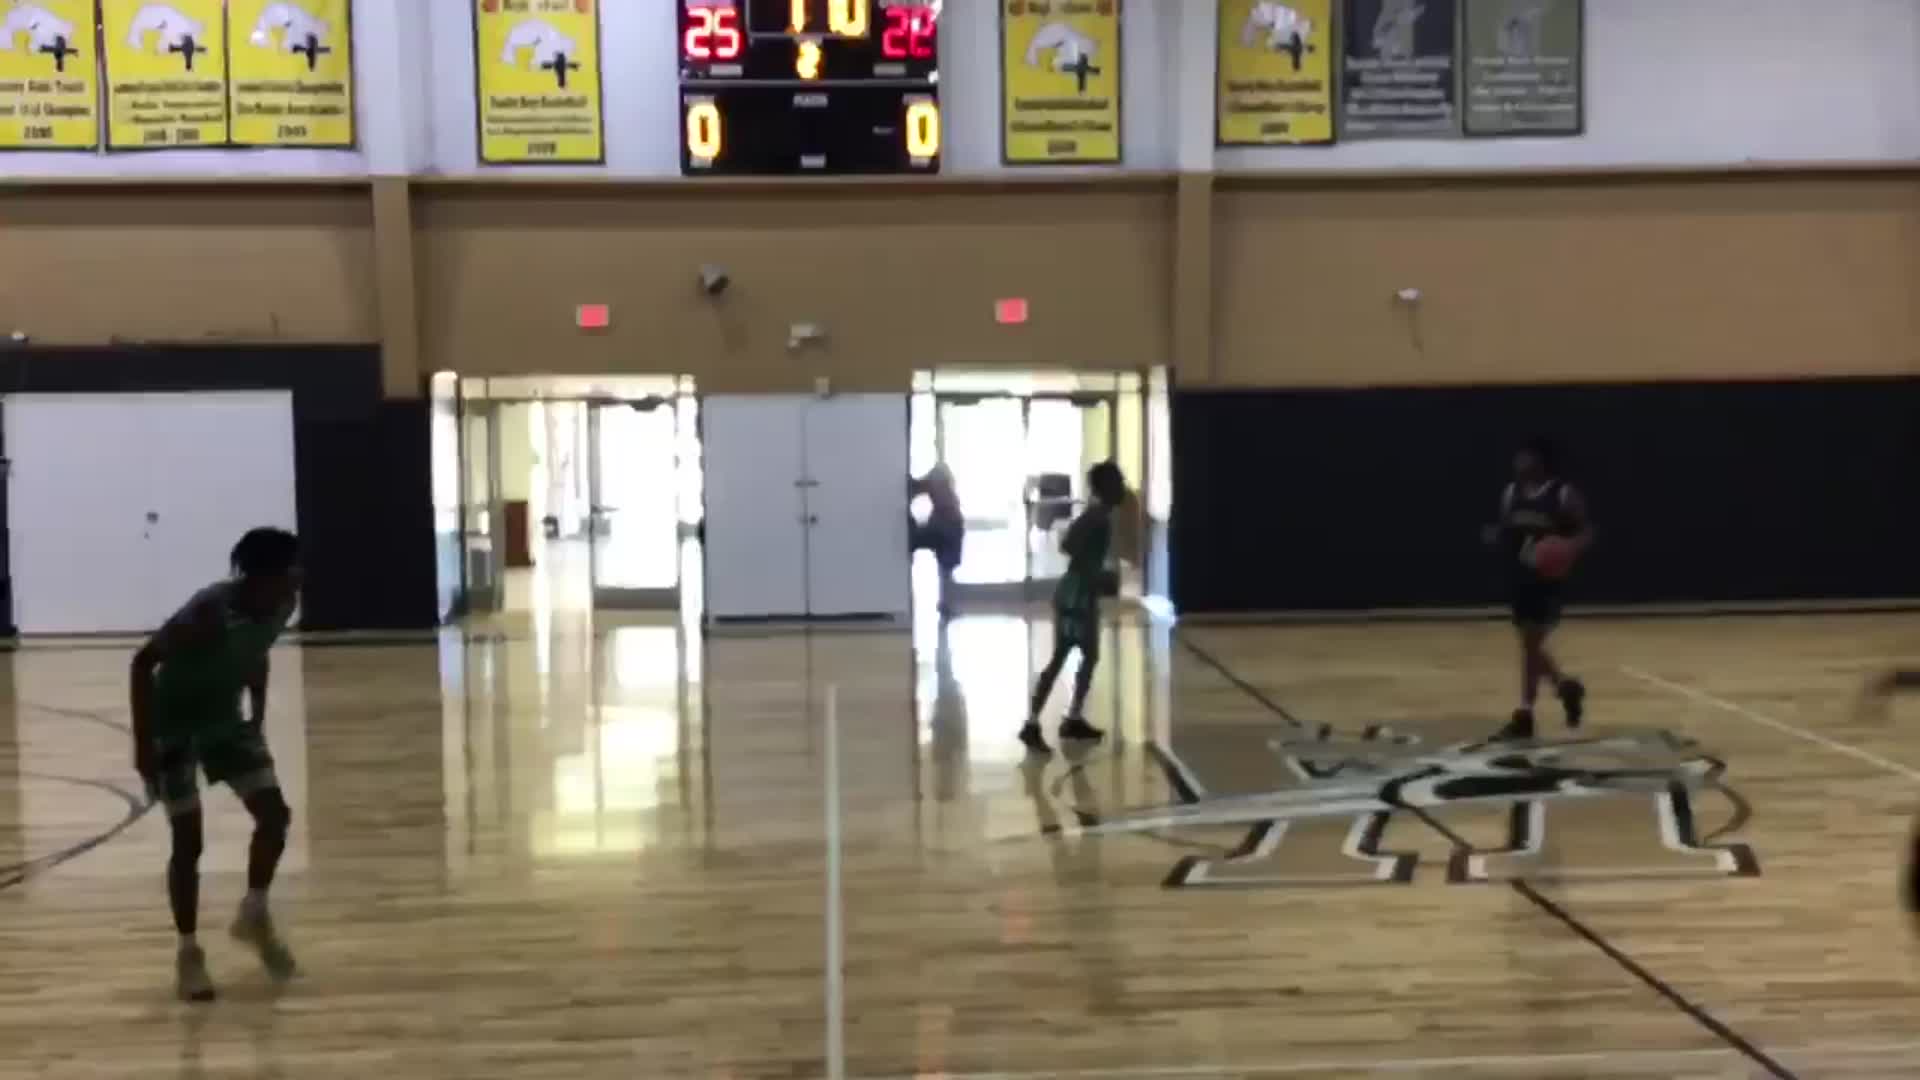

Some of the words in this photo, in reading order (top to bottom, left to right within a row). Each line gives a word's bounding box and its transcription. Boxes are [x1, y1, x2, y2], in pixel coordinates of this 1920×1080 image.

[685, 7, 742, 58] 25
[687, 103, 721, 158] 0
[906, 102, 939, 157] 0
